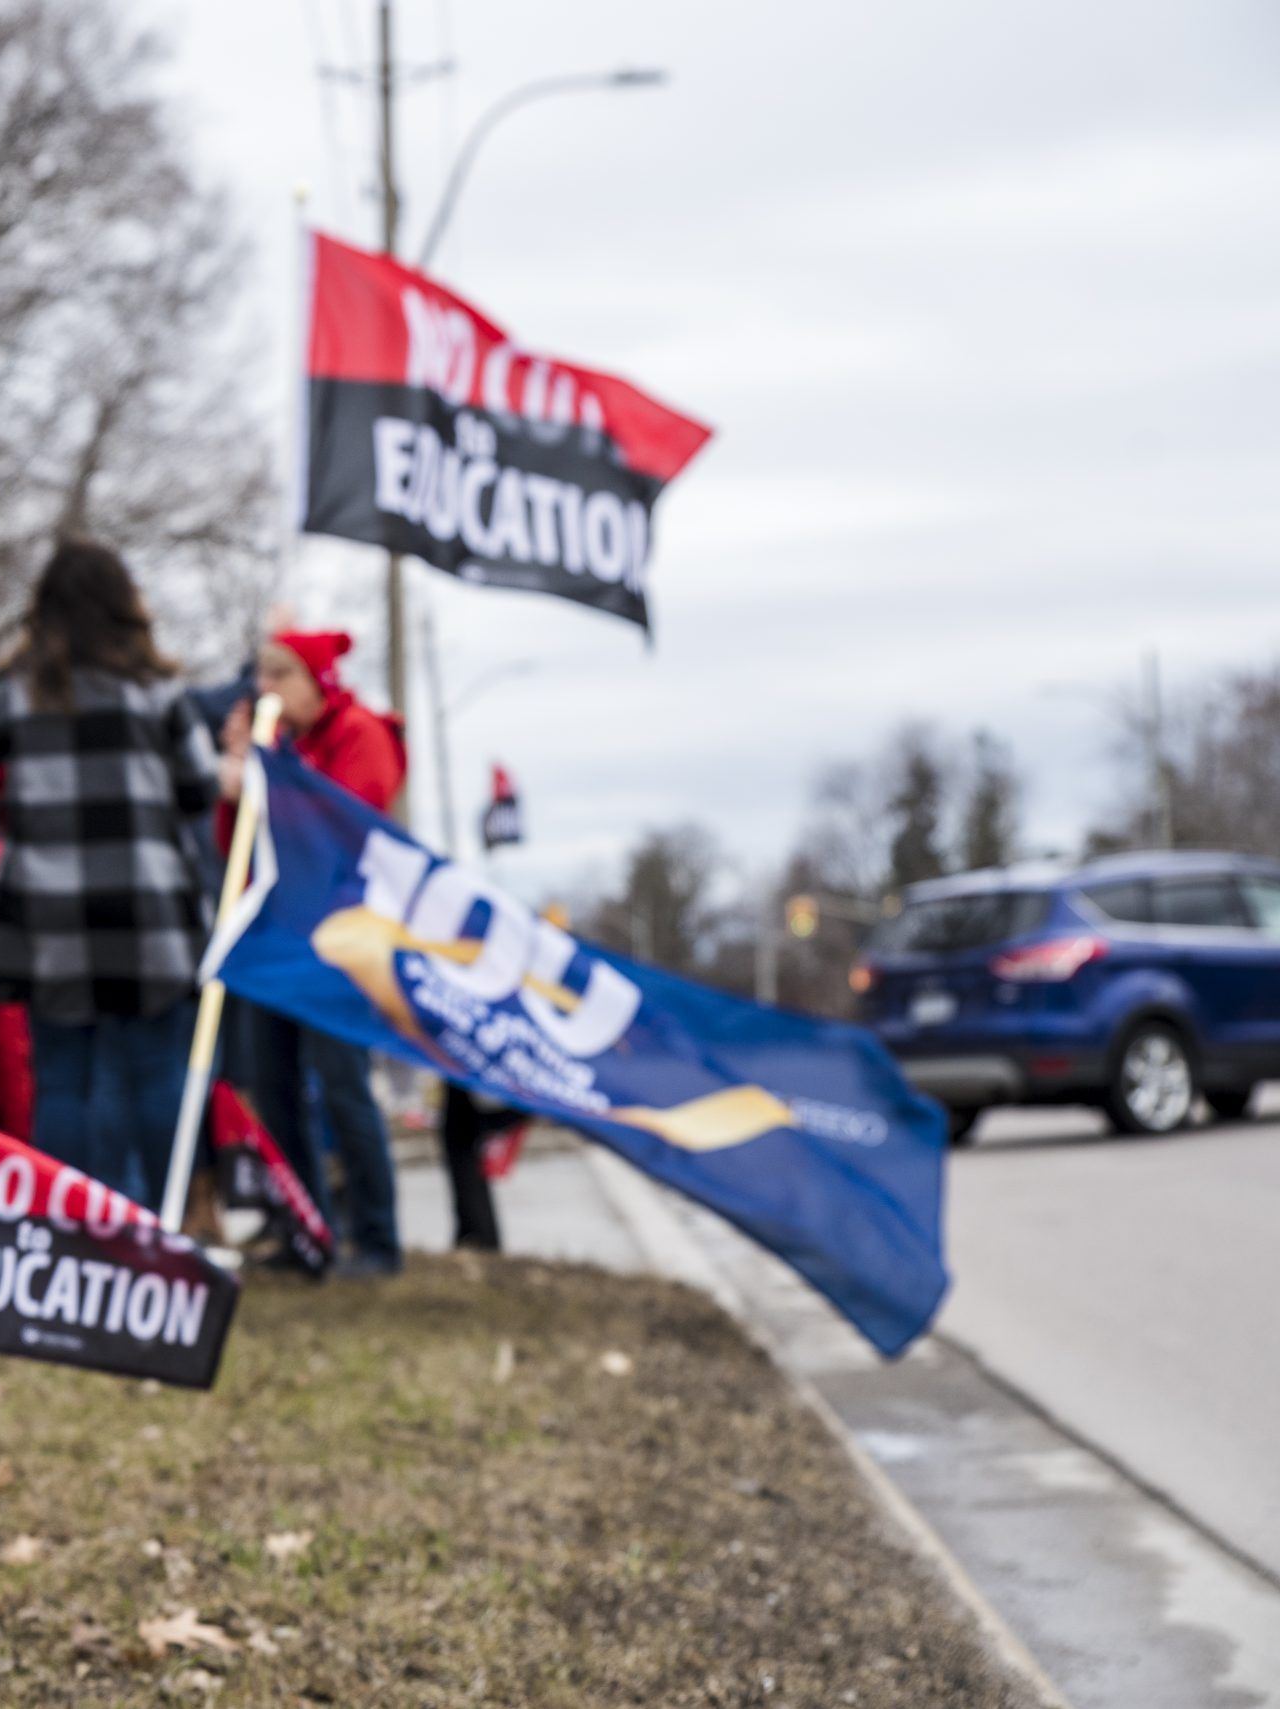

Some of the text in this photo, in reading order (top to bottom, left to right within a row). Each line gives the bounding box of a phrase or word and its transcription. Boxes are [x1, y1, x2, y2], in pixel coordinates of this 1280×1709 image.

[401, 288, 627, 465] NO CU
[17, 1224, 53, 1252] to
[48, 1166, 195, 1252] CU
